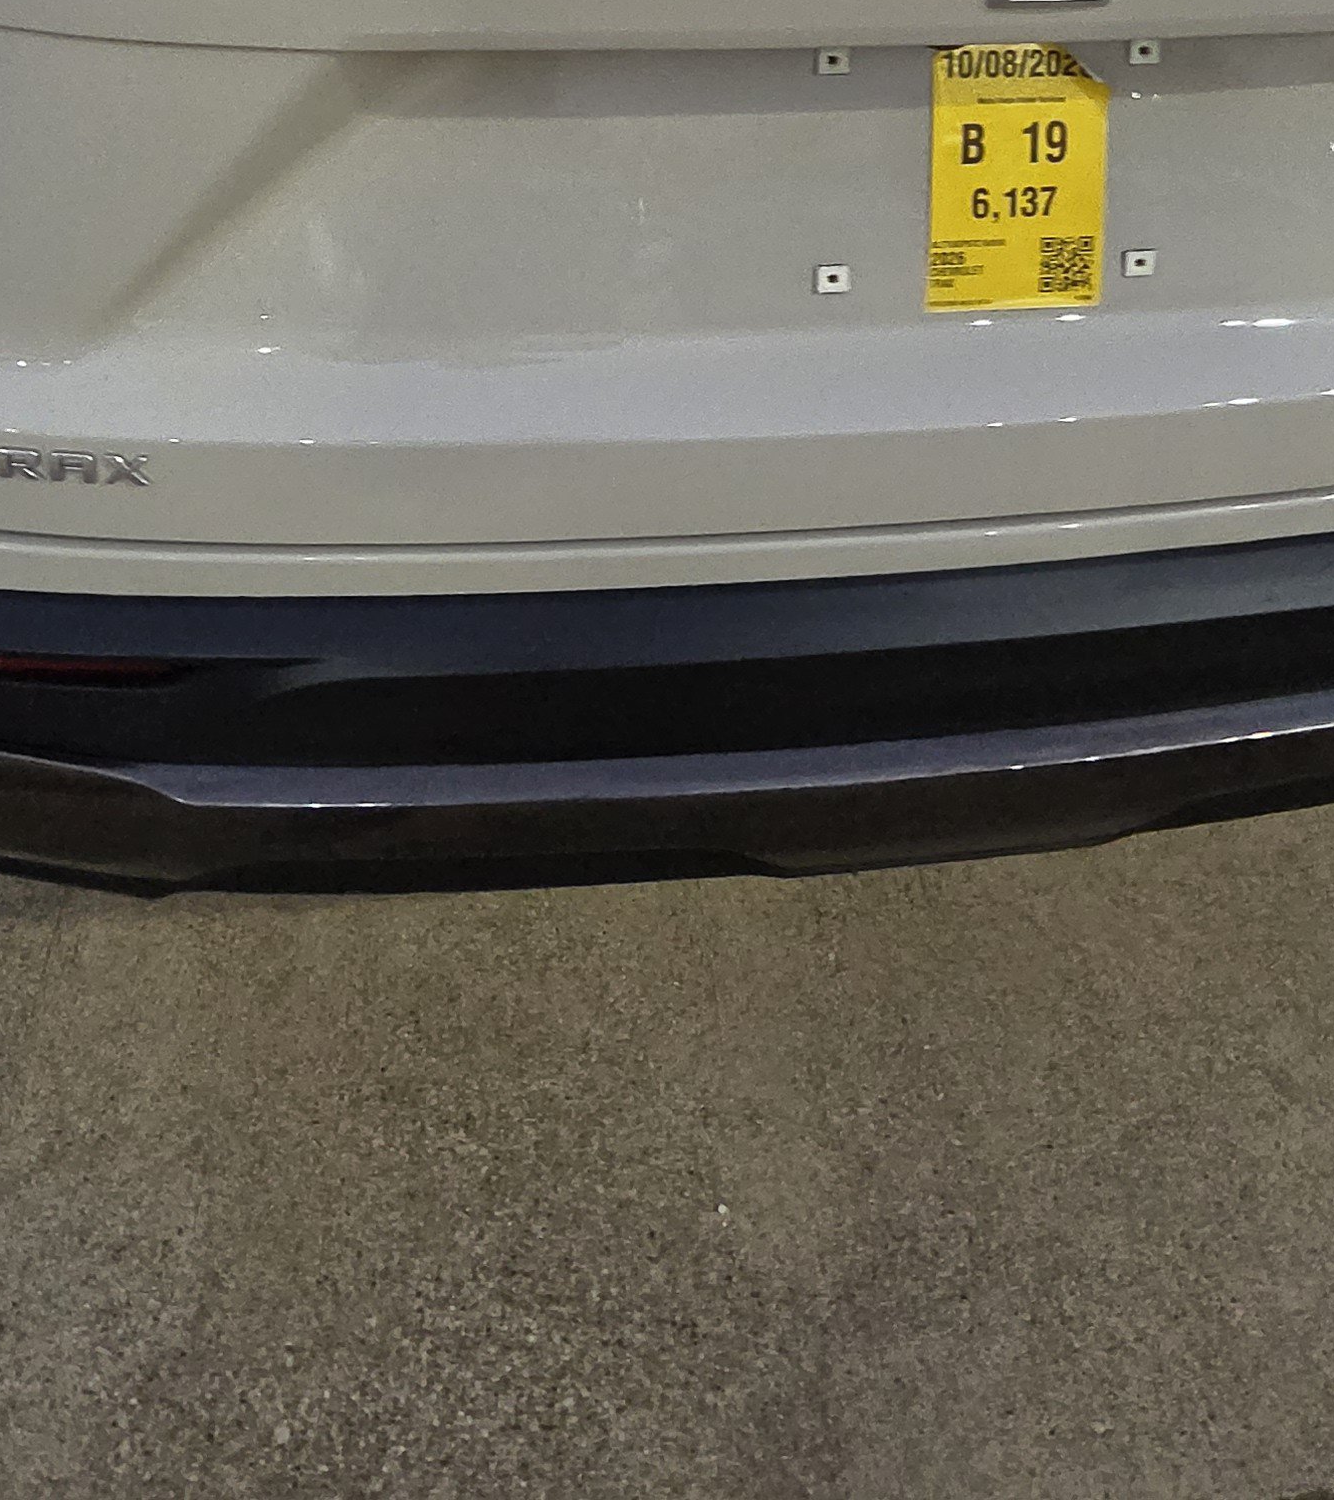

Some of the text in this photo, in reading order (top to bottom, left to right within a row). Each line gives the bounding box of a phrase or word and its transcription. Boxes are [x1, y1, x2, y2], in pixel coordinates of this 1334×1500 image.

[960, 121, 1068, 165] B 19
[972, 186, 1059, 222] 6,137
